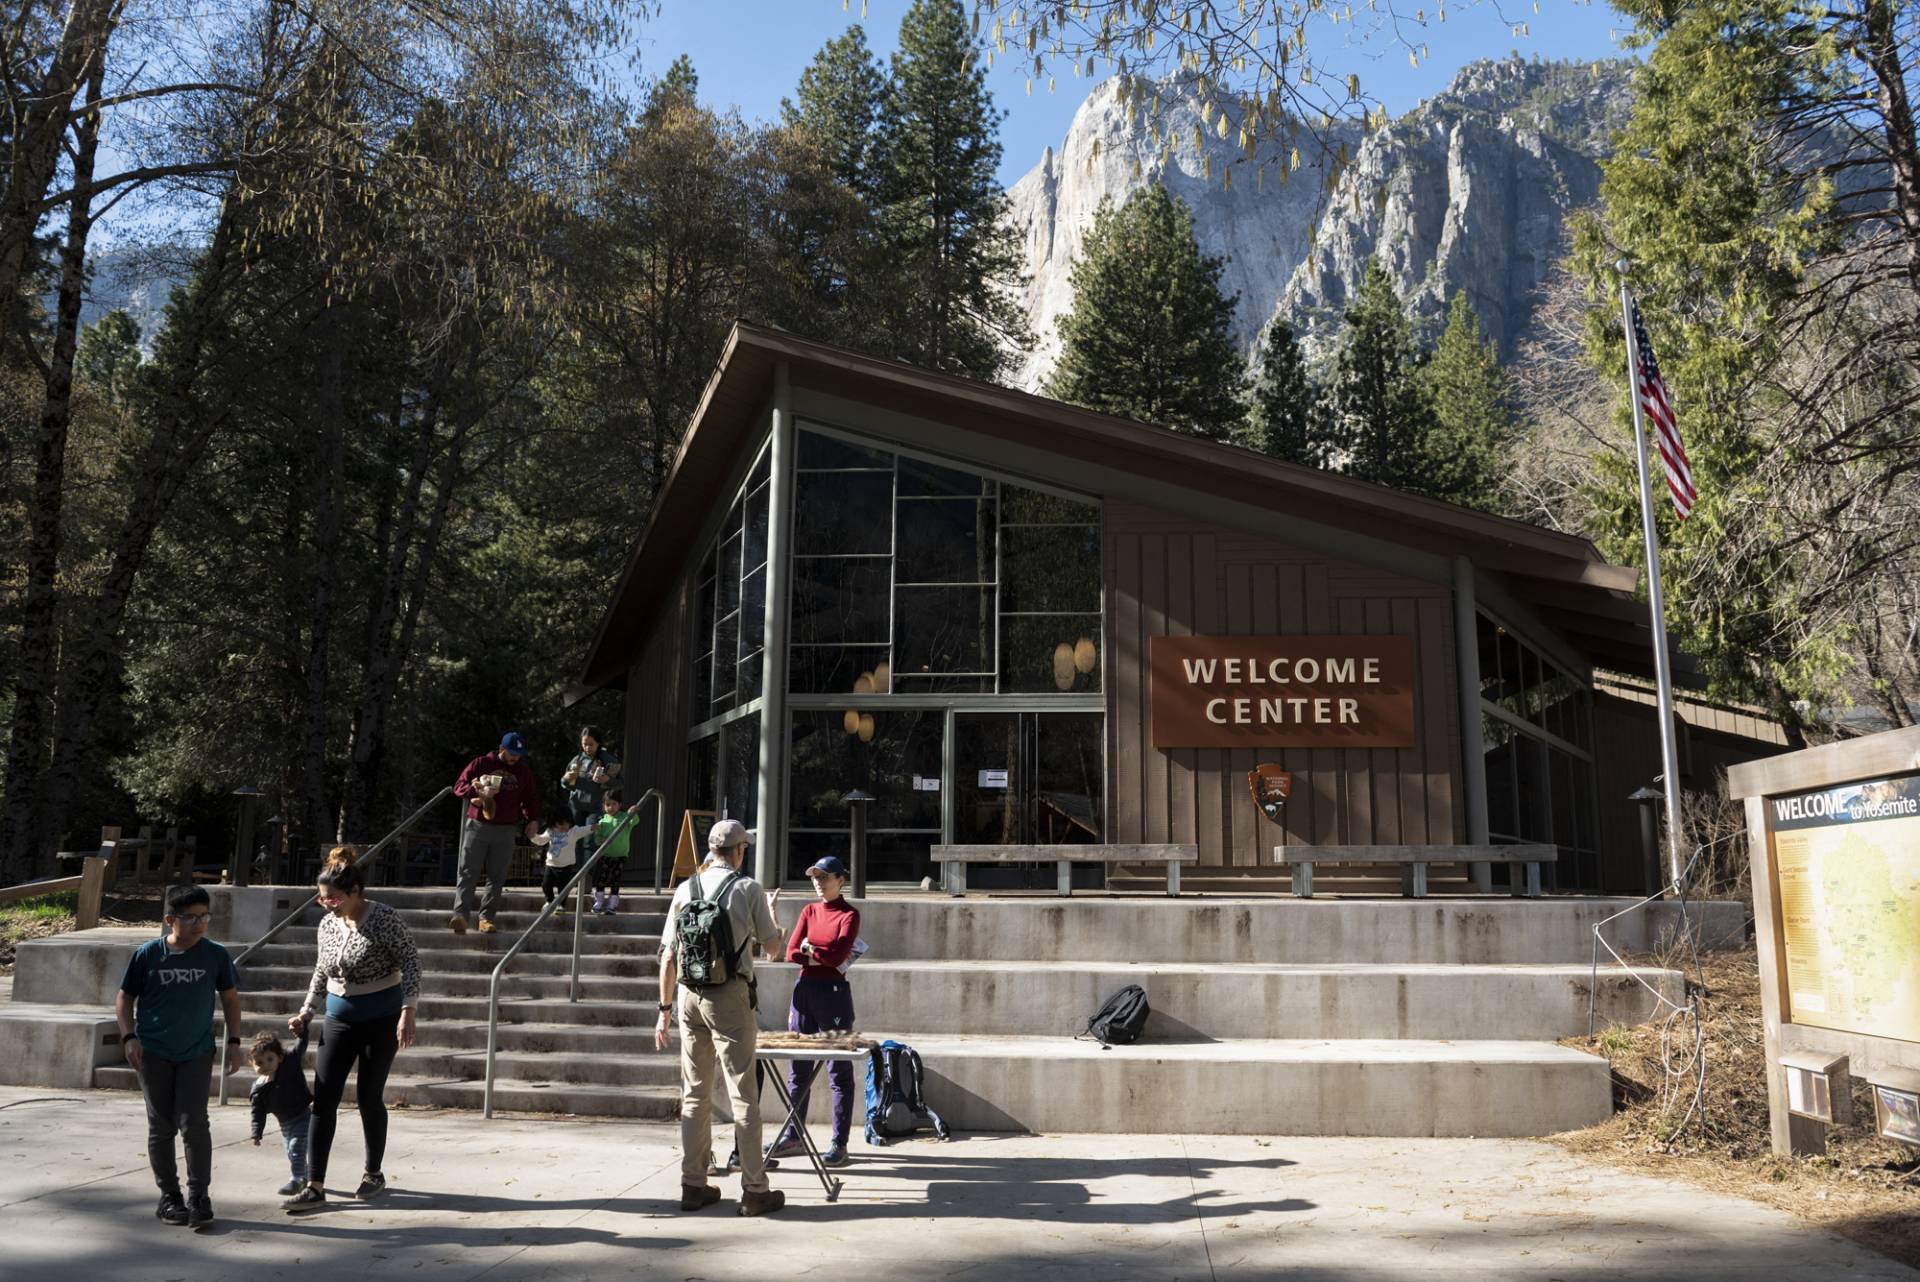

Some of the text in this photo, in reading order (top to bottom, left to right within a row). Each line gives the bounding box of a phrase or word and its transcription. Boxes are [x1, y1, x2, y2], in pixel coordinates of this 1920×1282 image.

[1182, 657, 1381, 684] WELCOME
[1206, 698, 1361, 724] CENTER
[1775, 792, 1849, 821] WELCOME
[1850, 803, 1860, 820] to
[1862, 795, 1918, 818] Yosemite
[157, 967, 207, 985] DRIP
